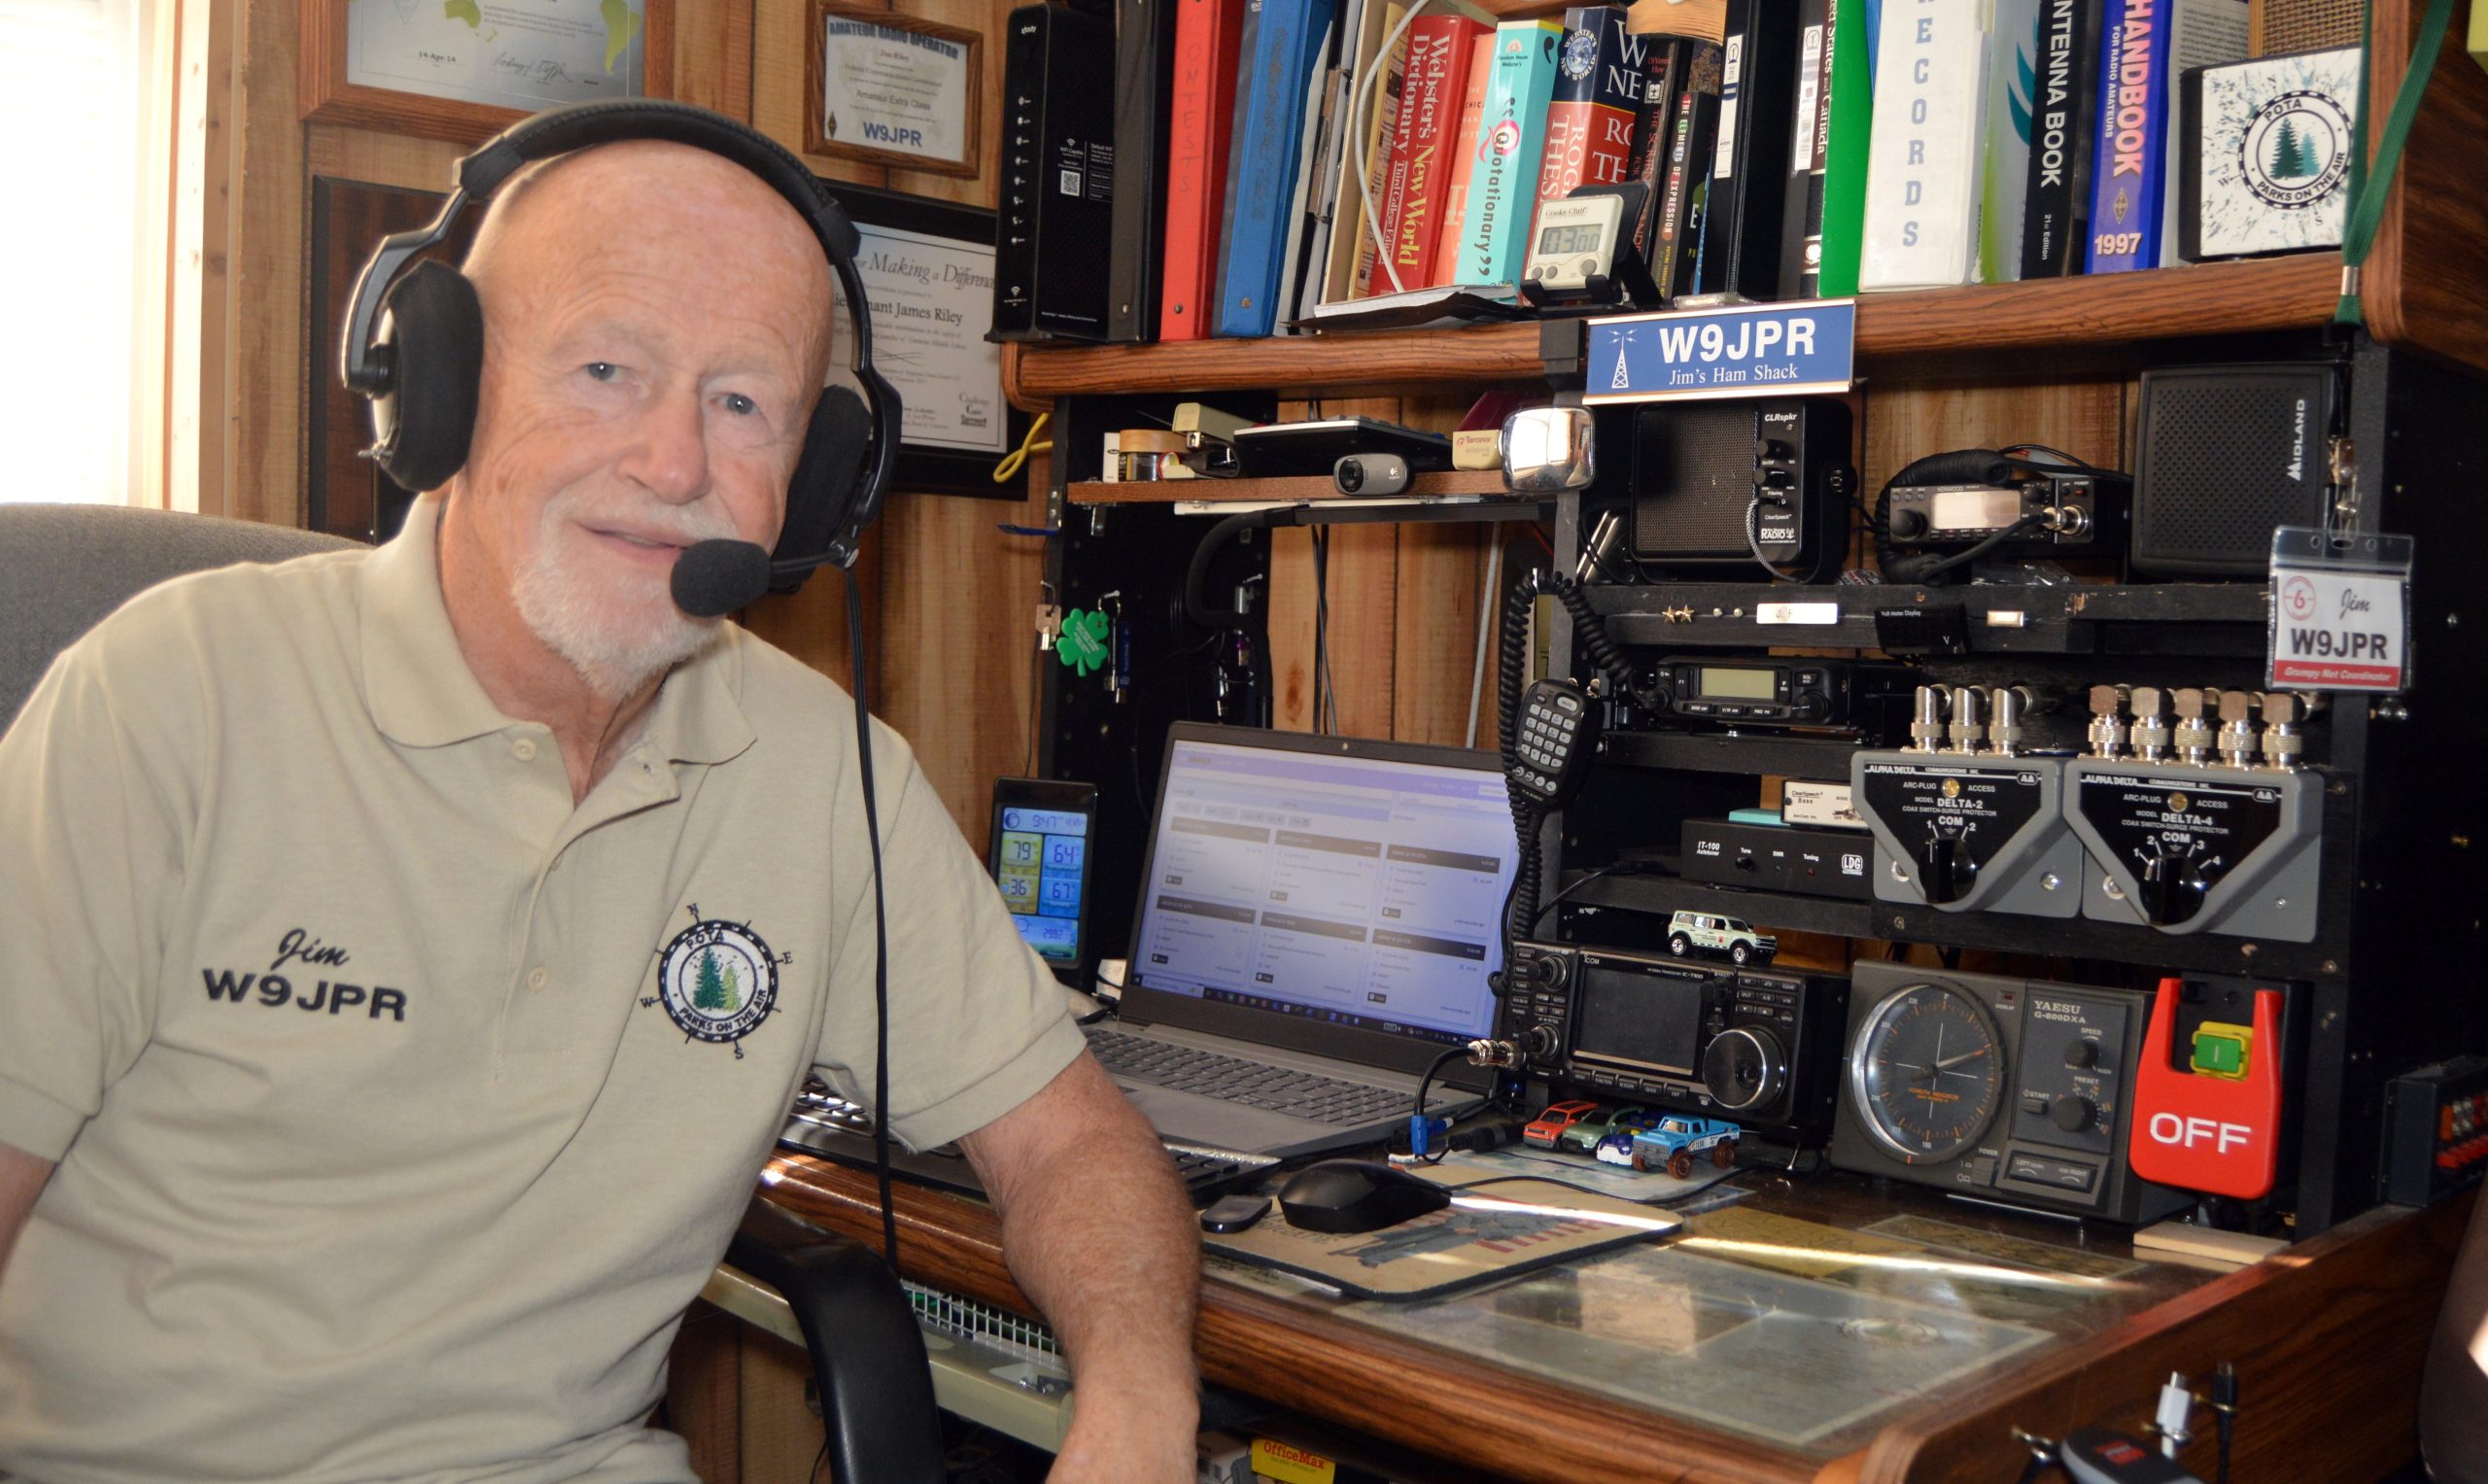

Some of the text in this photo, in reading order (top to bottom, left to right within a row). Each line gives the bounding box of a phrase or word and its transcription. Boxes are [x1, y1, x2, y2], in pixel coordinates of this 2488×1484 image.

[829, 21, 959, 59] AMATEUR RADIO OPERATOR
[1824, 26, 1836, 74] States
[1560, 56, 1572, 80] NEW
[2105, 25, 2121, 139] FOR RADIO AMATEURS
[856, 89, 931, 111] Amateur Extra Class
[1393, 34, 1431, 155] Dictionary
[2041, 0, 2072, 188] NTENNA BOOK
[2263, 98, 2302, 121] POTA
[1817, 94, 1831, 155] Canada
[1901, 0, 1934, 247] ECORDS
[863, 121, 922, 147] W9JPR
[1398, 34, 1451, 265] Webster's New World
[1664, 99, 1690, 234] THE ELEMENTS OF EXPRESSION
[2257, 151, 2346, 201] PARKS ON THE AIR
[1387, 161, 1404, 227] Third College
[2042, 231, 2052, 260] Edition
[2094, 232, 2142, 255] 1997
[869, 252, 930, 284] Making
[894, 302, 963, 328] James Riley
[1659, 318, 1816, 364] W9JPR
[1669, 362, 1798, 386] Jim's Ham Shack
[1764, 412, 1797, 423] CLRspkr
[2287, 398, 2306, 481] MIDLAND
[1761, 529, 1785, 539] RADIO
[2294, 590, 2305, 609] 6
[2339, 588, 2370, 620] Jim
[2291, 629, 2387, 660] W9JPR
[2285, 667, 2391, 681] Grumpy Net Coordinator
[1869, 765, 1894, 774] ALPHA
[1894, 766, 1916, 775] DELTA
[1903, 781, 1996, 793] ARC-PLUG ACCESS
[2086, 774, 2113, 784] ALPHA
[2113, 776, 2139, 786] DELTA
[1918, 807, 1961, 815] SWITCH-SURGE
[1937, 798, 1984, 810] DELTA-2
[2123, 793, 2229, 810] ARC-PLUG ACCESS
[1033, 814, 1056, 828] 9:47
[1926, 819, 1976, 832] 1 2
[1938, 815, 1963, 826] COM
[2161, 812, 2213, 825] DELTA-4
[2162, 832, 2191, 844] COM
[2189, 824, 2229, 835] PROTECTOR
[1014, 841, 1031, 860] 79
[1054, 844, 1074, 863] 64
[1698, 841, 1720, 850] IT-100
[2133, 835, 2221, 865] 1 2 3 4
[1803, 853, 1819, 862] Tuning
[1844, 856, 1861, 870] LDG
[1011, 880, 1026, 896] 36
[1053, 882, 1069, 899] 67
[686, 903, 699, 915] N
[685, 929, 725, 949] POTA
[270, 928, 350, 971] Jim
[781, 951, 793, 964] E
[202, 968, 407, 1022] W9JPR
[639, 996, 654, 1009] W
[678, 988, 767, 1032] PARKS ON THE AIR
[2033, 1000, 2081, 1015] YAESU
[2081, 1027, 2102, 1036] SPEED
[734, 1048, 744, 1059] S
[2074, 1075, 2099, 1085] PRESET
[2029, 1091, 2051, 1100] START
[2150, 1112, 2252, 1154] OFF
[1978, 1148, 1998, 1156] POWER
[1263, 1441, 1326, 1470] OfficeMax
